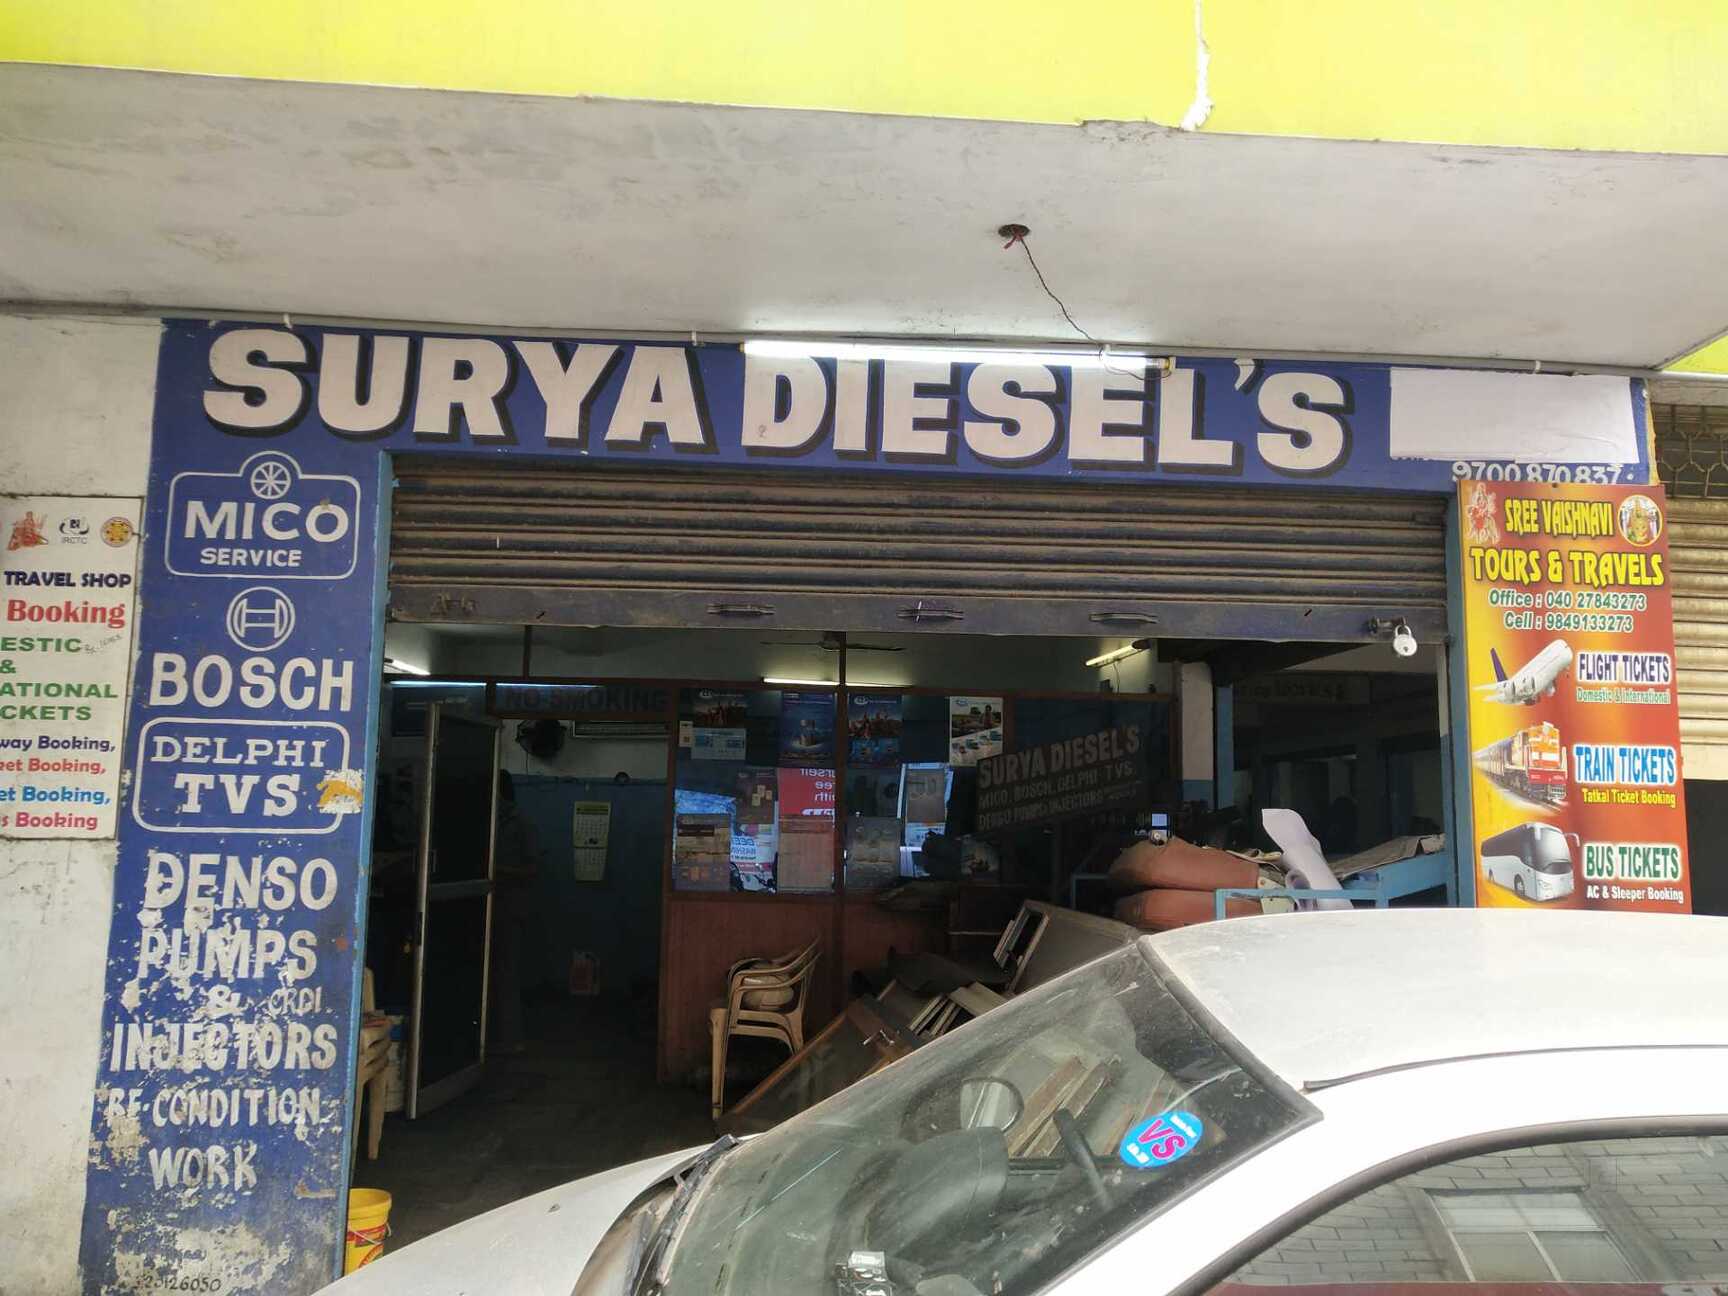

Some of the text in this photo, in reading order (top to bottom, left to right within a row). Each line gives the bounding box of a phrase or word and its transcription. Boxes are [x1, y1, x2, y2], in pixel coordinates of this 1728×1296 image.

[202, 329, 1348, 471] SURYA DIESEL'S
[183, 500, 349, 543] MICO
[1504, 497, 1615, 539] SREE VAISHNAVI
[200, 547, 302, 567] SERVICE
[1470, 546, 1665, 588] TOURS & TRAVELS
[4, 571, 132, 588] TRAVEL SHOP
[7, 599, 126, 629] Booking
[1489, 589, 1533, 606] Office
[1546, 591, 1572, 608] 040
[1576, 592, 1646, 610] 27843273
[1504, 611, 1532, 629] Cell
[1546, 613, 1633, 632] 9849133273
[0, 637, 82, 652] ESTIC
[0, 659, 17, 674] &
[149, 652, 354, 712] BOSCH
[1578, 652, 1670, 683] FLIGHT TICKETS
[0, 682, 119, 698] ATIONAL
[1576, 687, 1612, 702] Domestic
[0, 705, 92, 721] CKETS
[38, 736, 116, 752] Booking,
[151, 736, 329, 767] DELPHI
[28, 758, 107, 774] Booking,
[978, 747, 1049, 789] SURYA
[1575, 746, 1675, 784] TRAIN TICKETS
[22, 786, 111, 805] Booking,
[174, 773, 300, 816] TVS
[1581, 788, 1677, 808] Tatkal Ticket Booking
[16, 812, 98, 830] Booking
[1585, 845, 1679, 879] BUS TICKETS
[143, 850, 338, 911] DENSO
[1586, 886, 1684, 904] AC & Sleeper Booking
[136, 926, 318, 980] PUMPS
[203, 985, 246, 1016] &
[110, 1021, 338, 1073] INJECTORS
[1139, 1118, 1187, 1159] VS
[148, 1144, 258, 1191] WORK
